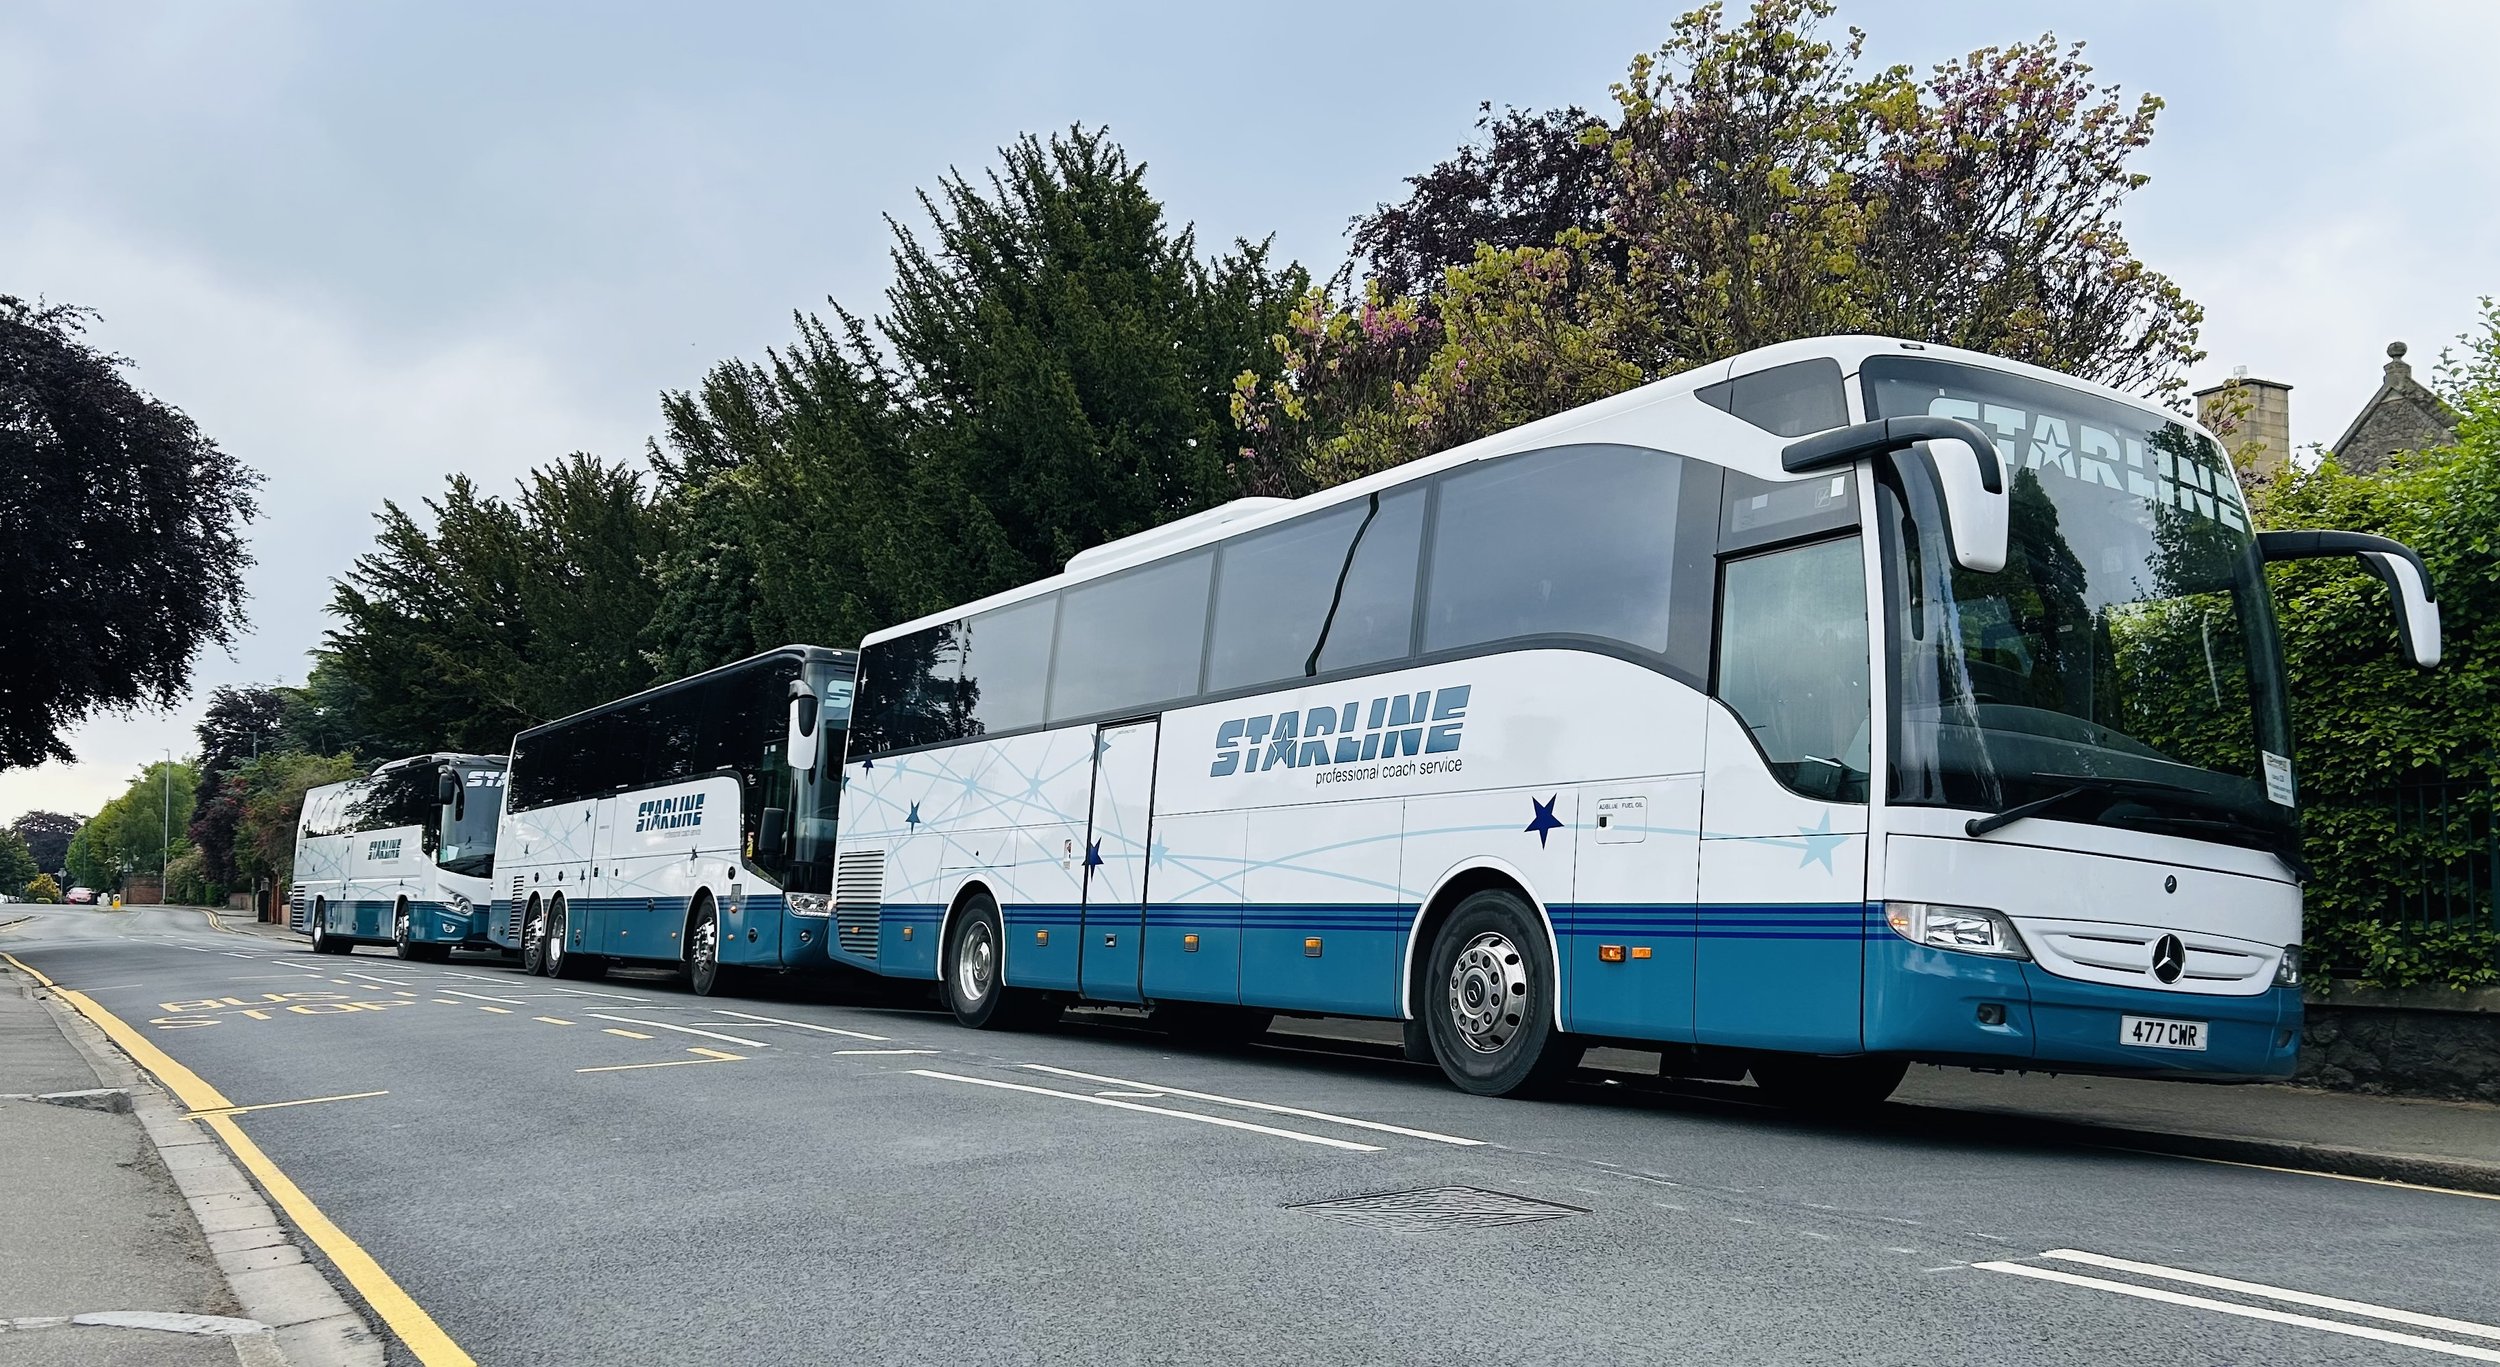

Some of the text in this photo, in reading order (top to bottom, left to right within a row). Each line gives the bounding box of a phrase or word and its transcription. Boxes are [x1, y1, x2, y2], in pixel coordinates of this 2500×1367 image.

[1210, 685, 1471, 777] STARLINE
[1315, 756, 1462, 787] professional coach service
[636, 793, 705, 832] STARLINE
[149, 1000, 416, 1029] STOP
[158, 992, 349, 1012] BUS
[2133, 1021, 2197, 1046] 477 CWR
